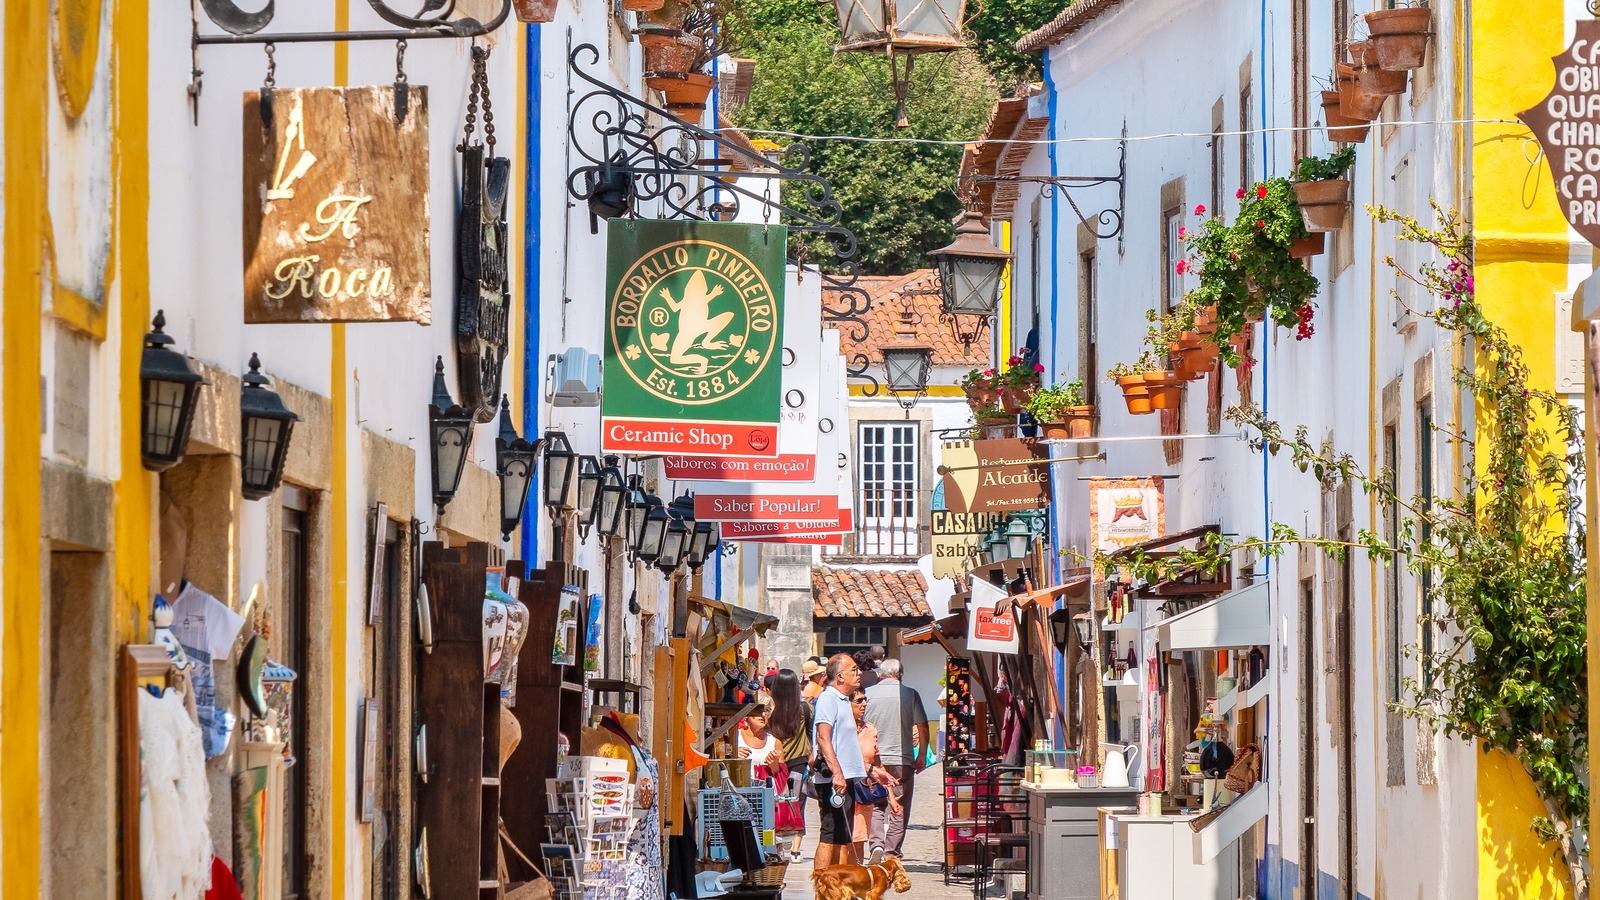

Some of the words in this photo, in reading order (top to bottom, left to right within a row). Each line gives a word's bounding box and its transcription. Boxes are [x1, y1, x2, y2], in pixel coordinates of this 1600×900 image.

[1560, 65, 1600, 92] ÓBI
[301, 195, 372, 242] A
[264, 255, 393, 300] Roca
[616, 247, 689, 328] BORDALLO
[705, 247, 773, 332] PINHEIRO
[646, 368, 678, 396] Est.
[686, 369, 740, 398] 1884
[610, 425, 684, 443] Ceramic
[688, 428, 733, 450] Shop
[666, 455, 716, 469] Sabores
[721, 460, 749, 471] com
[753, 459, 809, 474] emoção!
[982, 468, 1048, 487] Alcaide
[714, 498, 755, 512] Saber
[760, 498, 821, 516] Popular!
[733, 522, 779, 533] Sabores
[932, 511, 976, 534] CASA
